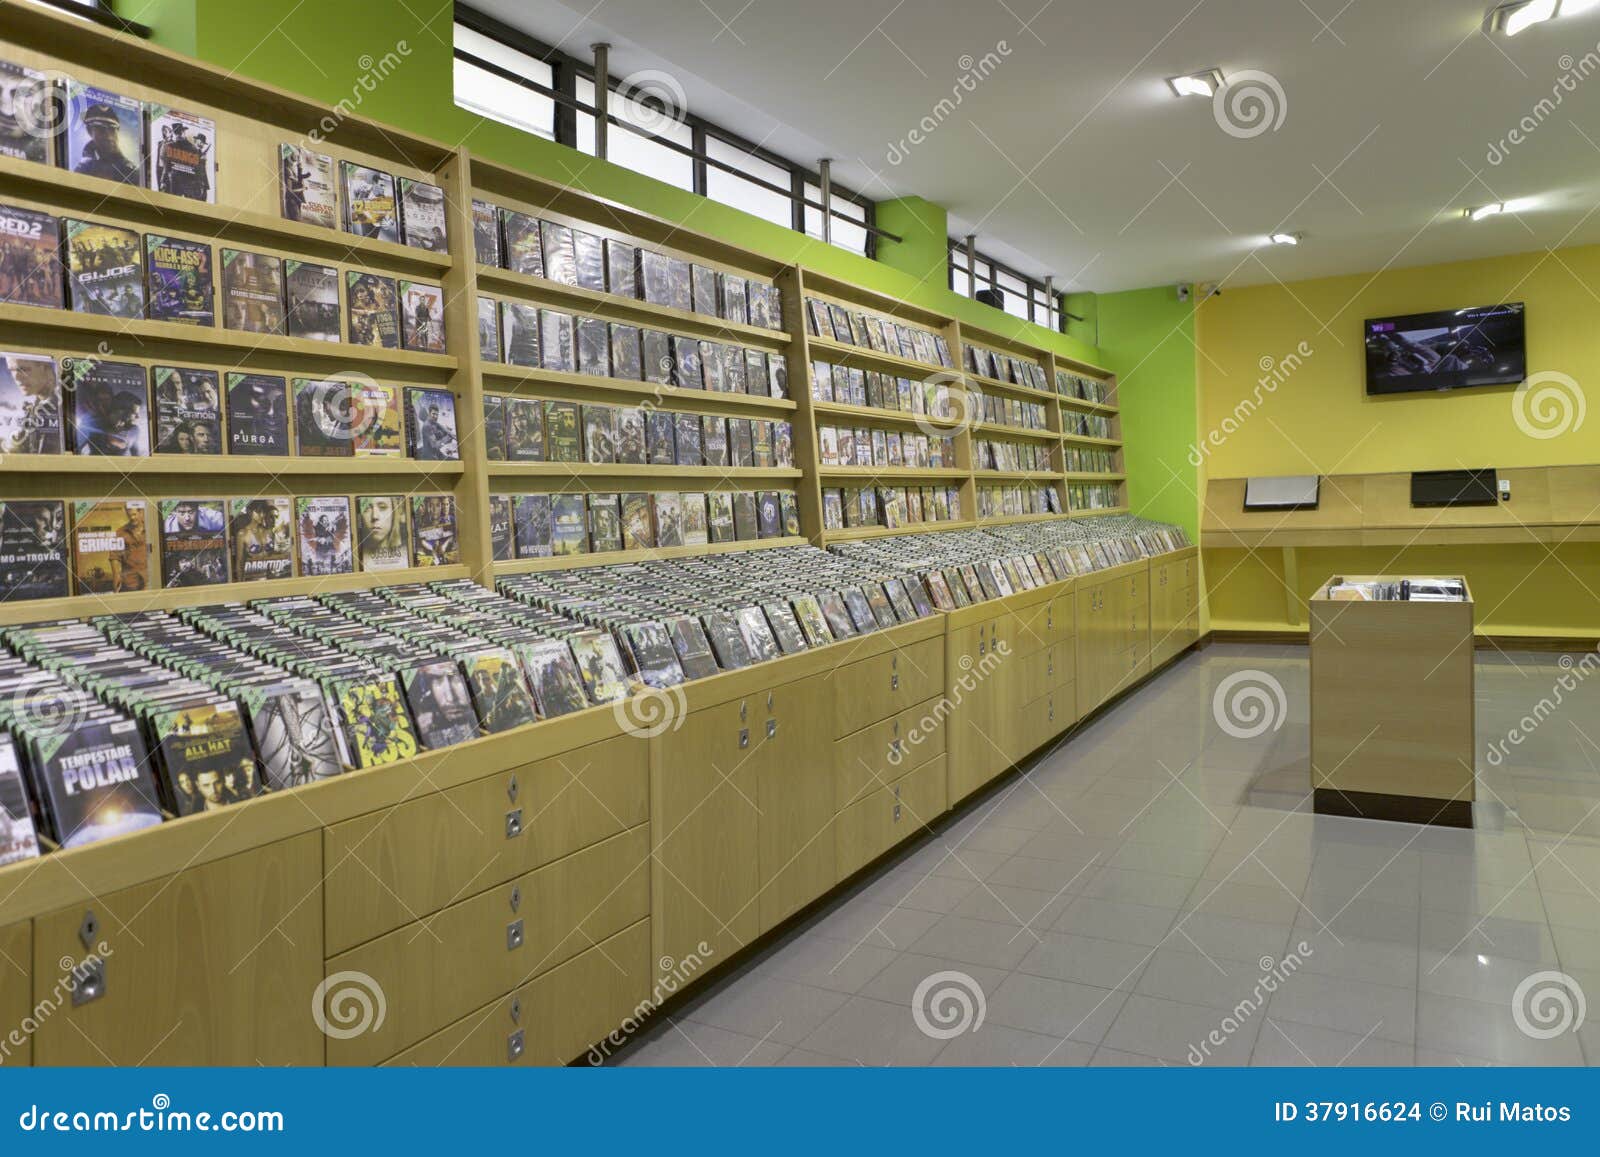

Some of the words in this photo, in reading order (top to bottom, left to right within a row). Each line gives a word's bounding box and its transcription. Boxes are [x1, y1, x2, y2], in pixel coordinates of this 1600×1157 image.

[154, 247, 200, 266] KICK-ASS
[233, 434, 275, 445] PURGA
[79, 537, 125, 552] GRINGO
[60, 744, 133, 770] TEMPESTADE
[184, 745, 207, 759] ALL
[63, 757, 139, 797] POLAR
